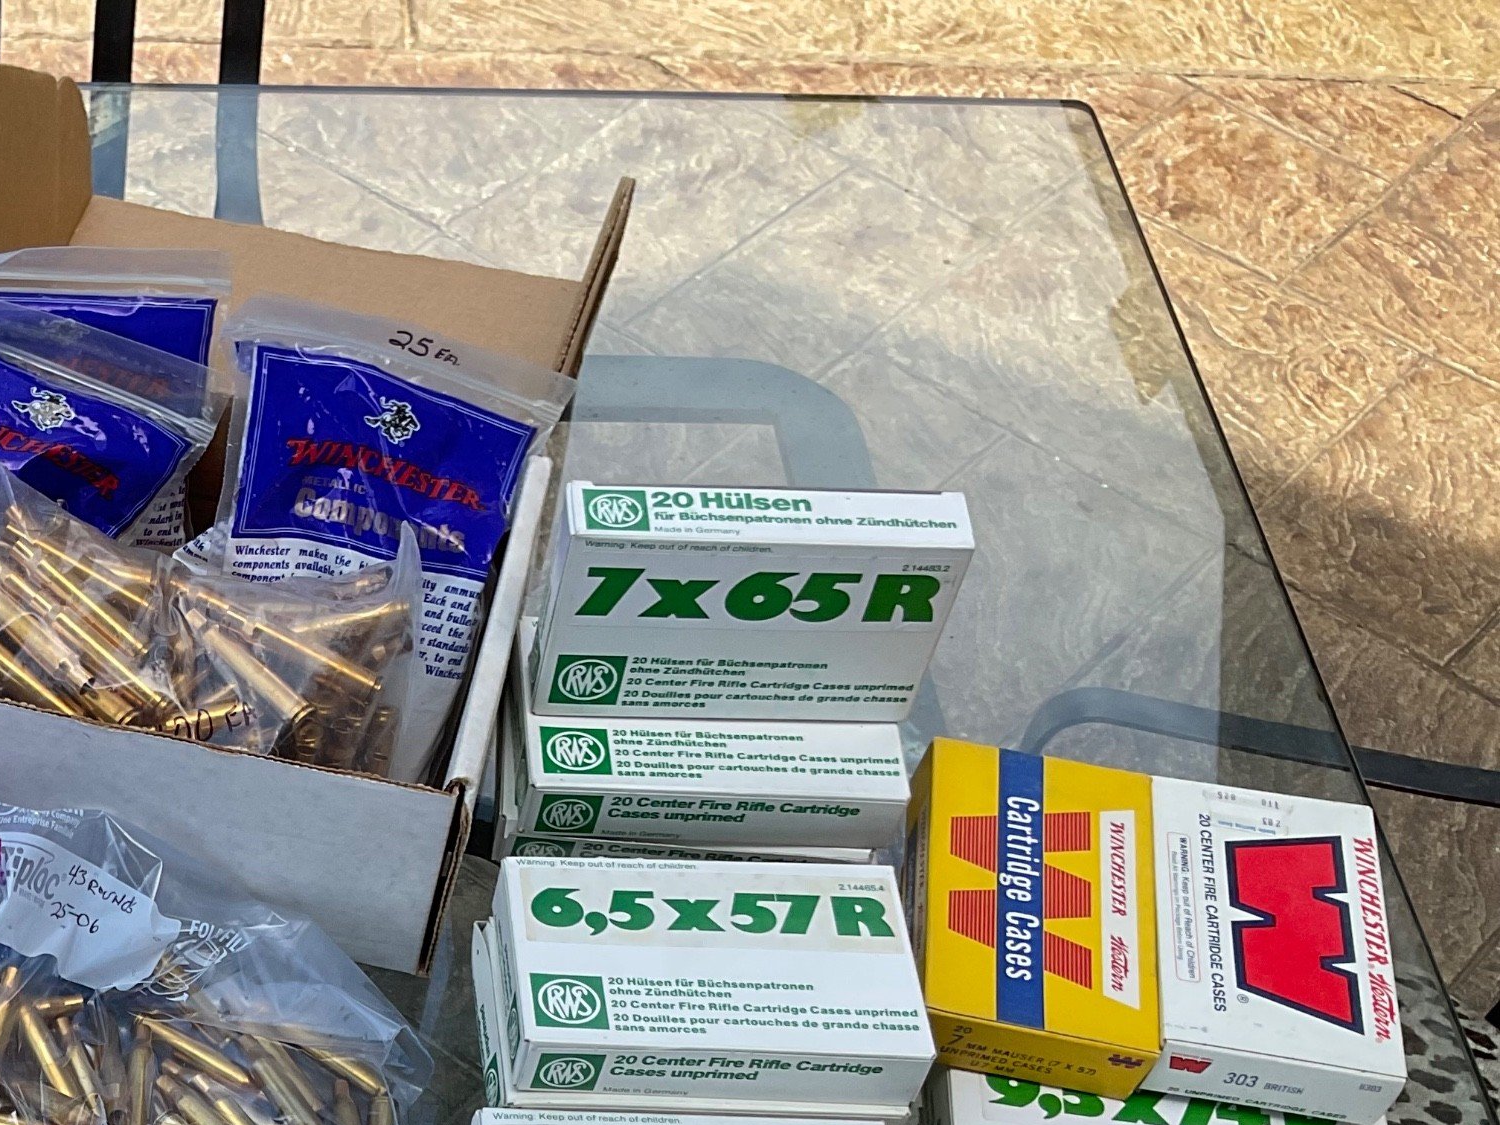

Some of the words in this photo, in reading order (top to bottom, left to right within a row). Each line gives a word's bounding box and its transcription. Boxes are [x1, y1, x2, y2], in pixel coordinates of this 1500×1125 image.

[389, 330, 434, 358] 25
[286, 437, 487, 511] WINCHESTER
[651, 491, 694, 508] 20
[700, 492, 812, 512] Hülsen
[654, 512, 676, 521] für
[679, 512, 812, 527] Büchsenpatronen
[816, 517, 852, 526] ohne
[857, 516, 957, 530] Zündhütchen
[654, 526, 682, 534] Made
[696, 527, 740, 536] Germany
[233, 559, 290, 571] components
[295, 562, 336, 576] available
[235, 545, 290, 557] Winchester
[299, 549, 328, 561] makes
[335, 554, 352, 568] the
[1199, 814, 1211, 827] 20
[999, 796, 1040, 902] Cartridge
[1200, 830, 1214, 874] CENTER
[68, 864, 87, 886] 43
[1110, 822, 1127, 916] WINCHESTER
[1205, 878, 1217, 901] FIRE
[1353, 836, 1388, 965] WINCHESTER
[1005, 912, 1039, 981] Cases
[1206, 905, 1222, 970] CARTRIDGE
[1110, 935, 1129, 992] Western
[1212, 973, 1226, 1012] CASES
[1367, 971, 1397, 1041] Western
[993, 1048, 1043, 1064] MAUSER
[1223, 1072, 1258, 1088] 303
[1263, 1082, 1304, 1094] BRITISH
